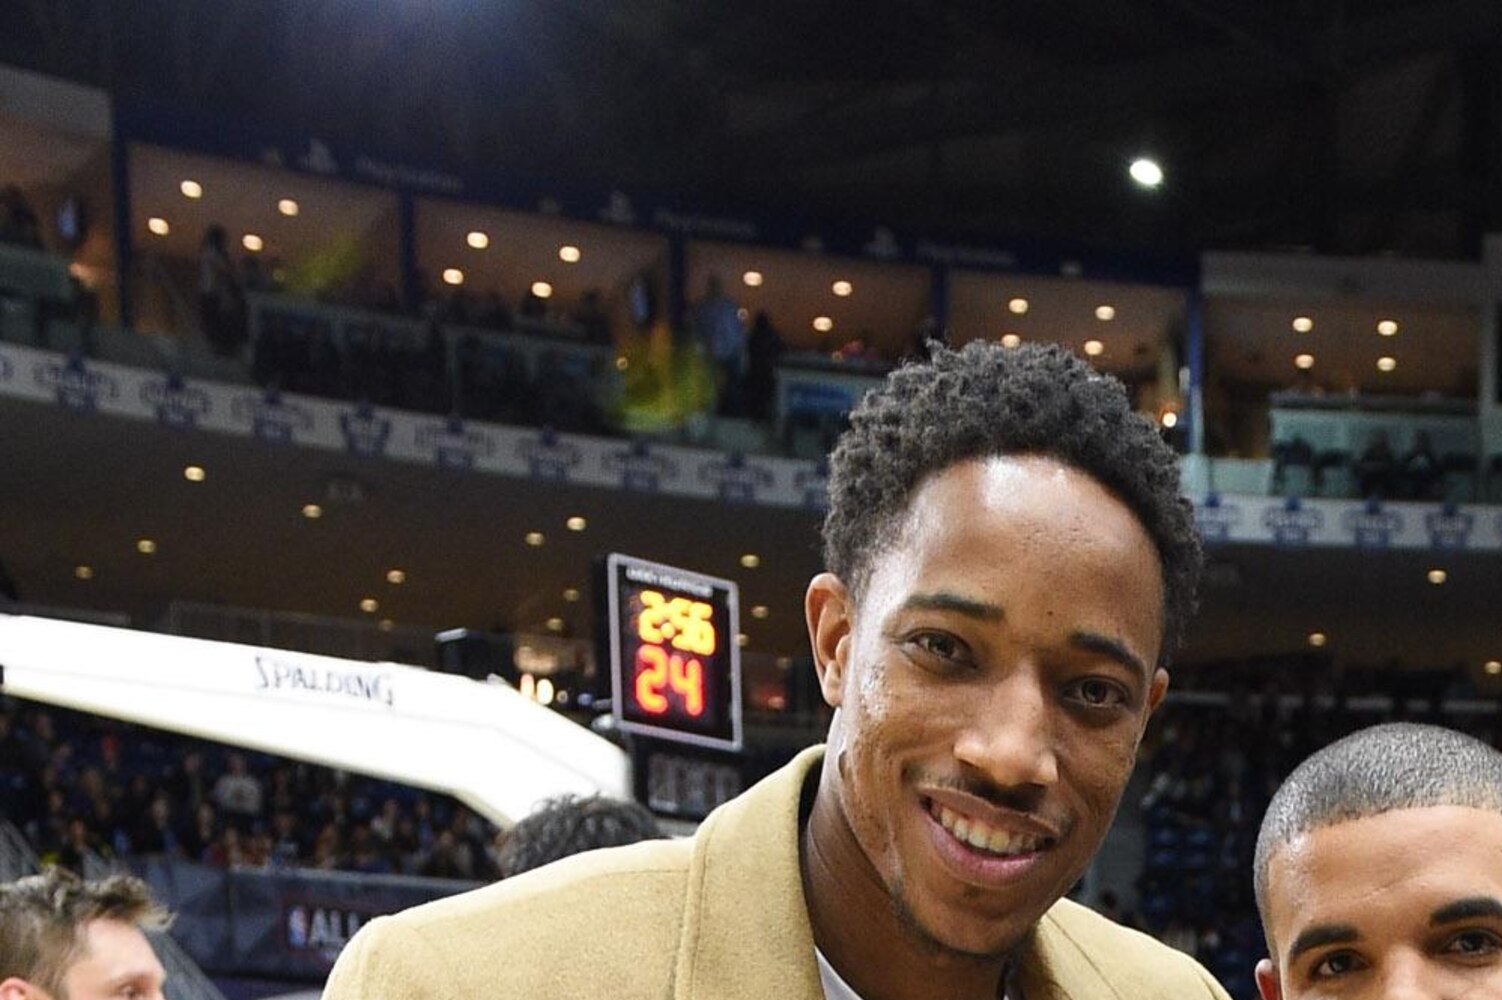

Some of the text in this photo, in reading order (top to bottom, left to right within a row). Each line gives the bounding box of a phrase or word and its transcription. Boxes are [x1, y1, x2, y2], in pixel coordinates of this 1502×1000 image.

[638, 589, 716, 656] 2:56
[254, 655, 394, 708] SPALDING
[635, 644, 704, 717] 24
